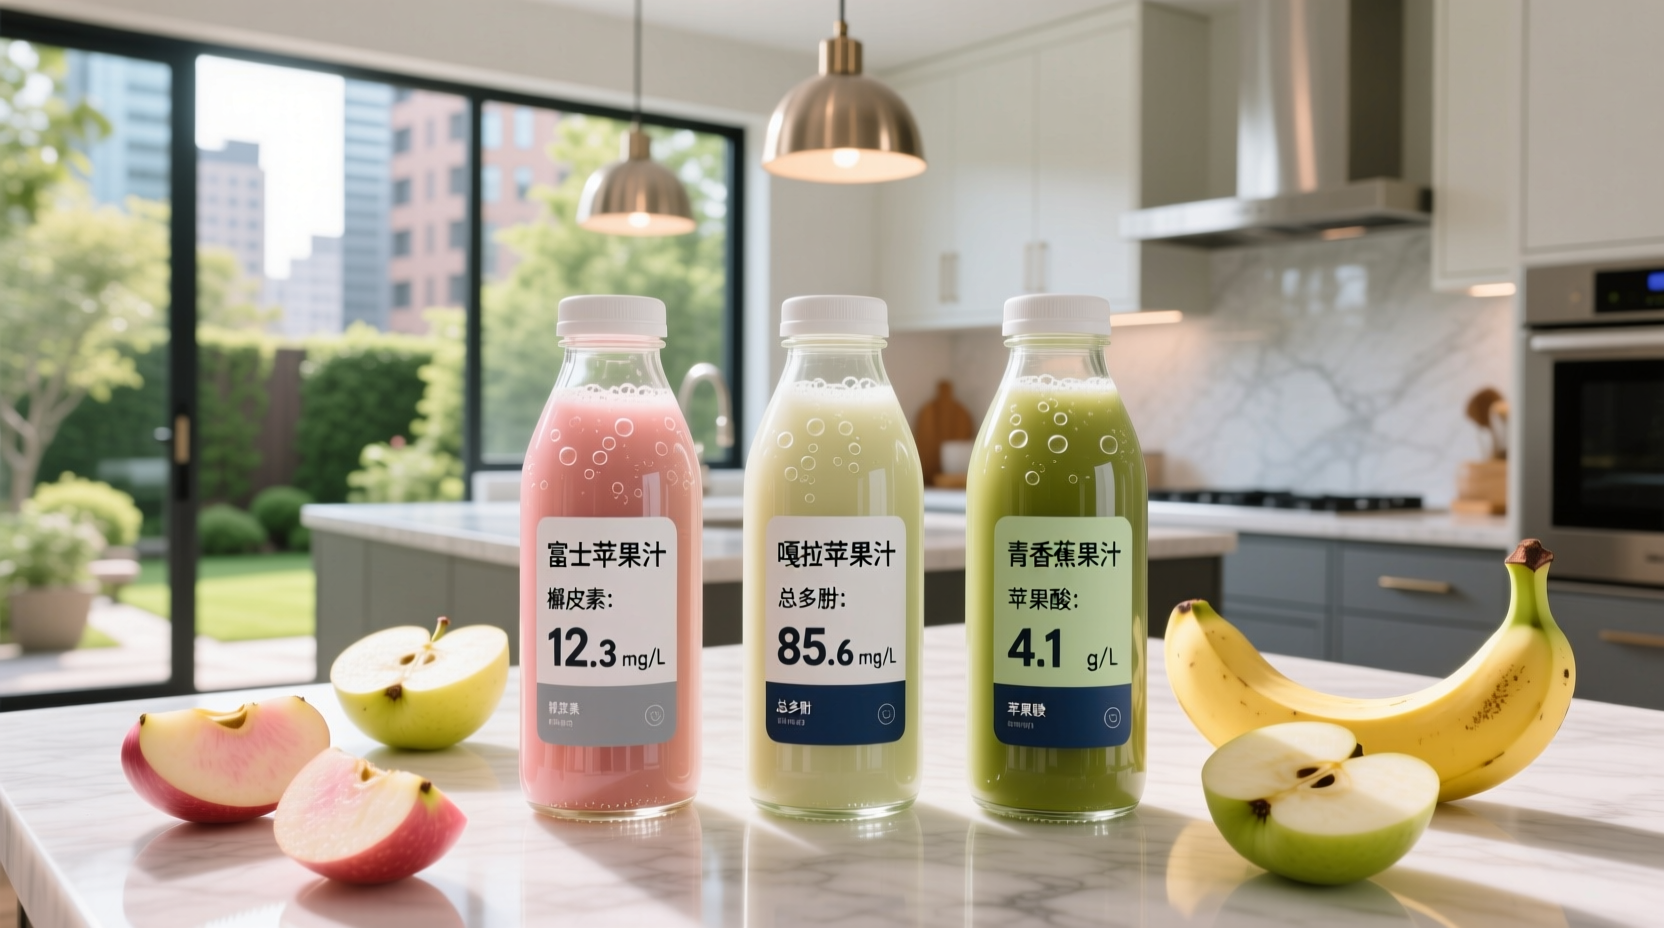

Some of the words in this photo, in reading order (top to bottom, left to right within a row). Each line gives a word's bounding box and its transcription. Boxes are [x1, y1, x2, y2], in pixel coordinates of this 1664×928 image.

[548, 540, 666, 568] 富士苹果汁
[778, 540, 896, 568] 嘎拉苹果汁
[1008, 540, 1121, 567] 青香蕉果汁
[548, 627, 616, 667] 12.3
[622, 647, 665, 670] mg/L
[778, 626, 853, 666] 85.6
[858, 647, 896, 669] mg/L
[1008, 628, 1060, 667] 4.1
[1087, 647, 1118, 671] g/L
